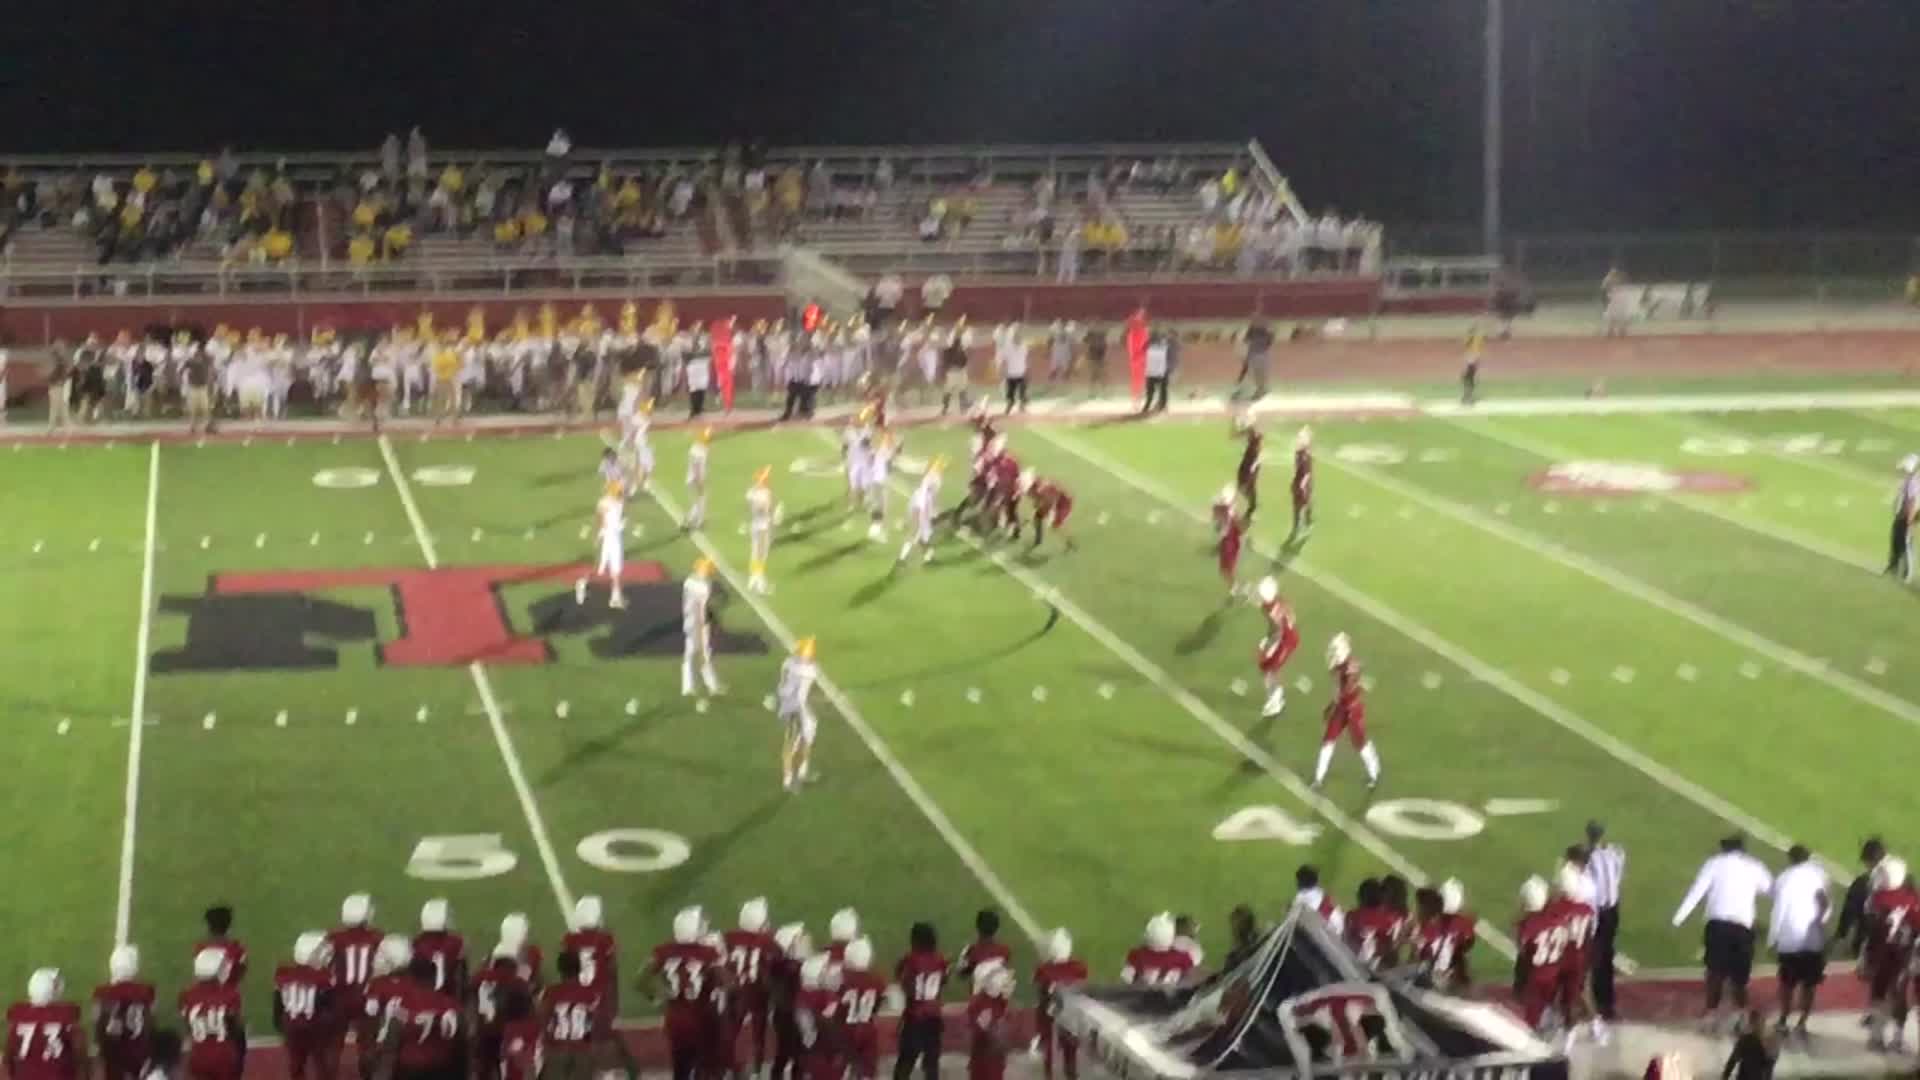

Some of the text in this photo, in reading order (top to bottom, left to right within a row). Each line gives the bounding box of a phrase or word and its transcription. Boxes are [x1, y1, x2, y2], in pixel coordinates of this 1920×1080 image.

[407, 830, 691, 880] 50
[345, 944, 370, 985] 11
[188, 1003, 228, 1043] 64
